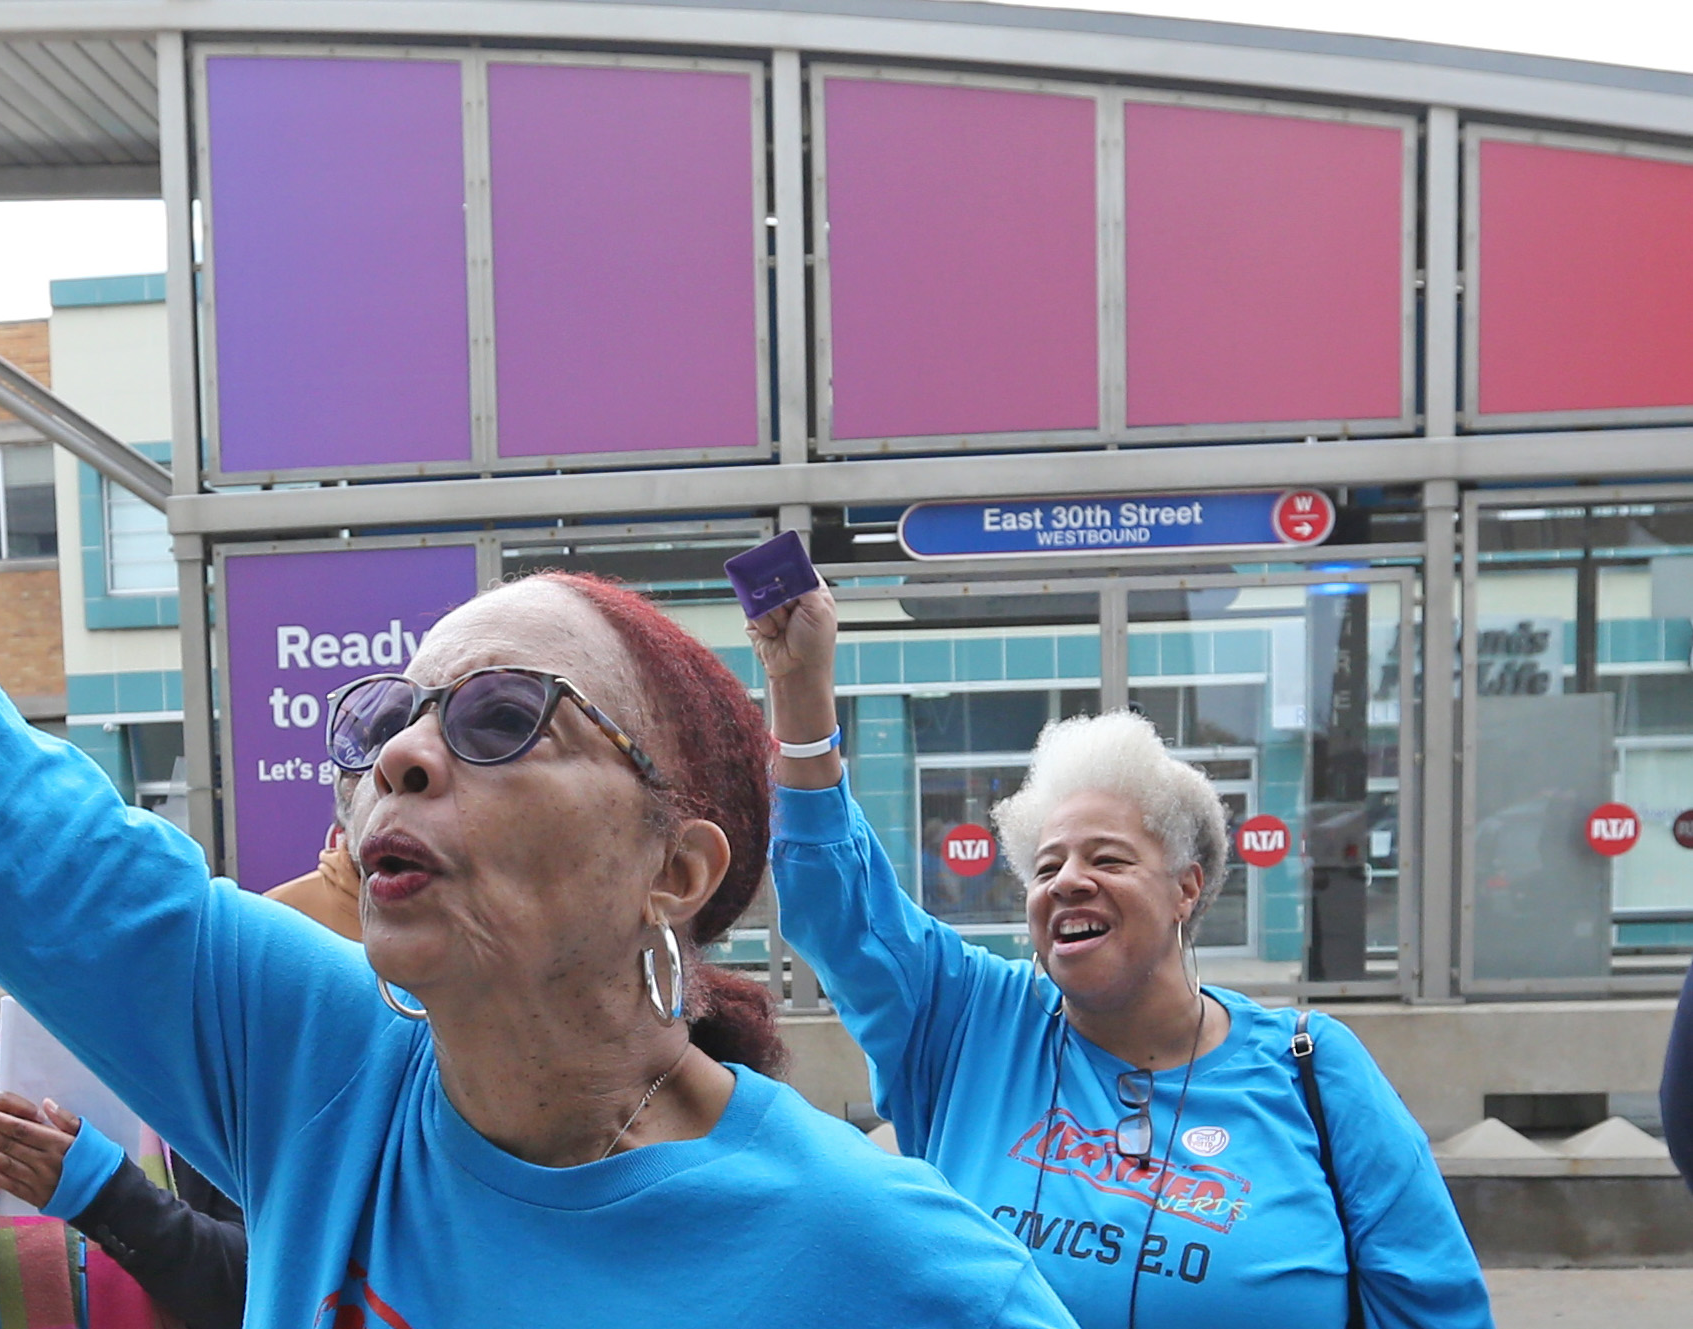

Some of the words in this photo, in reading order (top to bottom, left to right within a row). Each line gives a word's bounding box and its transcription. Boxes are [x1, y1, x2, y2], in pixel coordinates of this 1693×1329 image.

[1294, 495, 1314, 513] W
[983, 507, 1044, 532] East
[1051, 504, 1112, 529] 30th
[1119, 502, 1203, 527] Street
[1036, 527, 1150, 546] WESTBOUND
[269, 687, 320, 728] to
[258, 757, 314, 781] Let's
[1243, 829, 1285, 852] RTA
[1591, 817, 1635, 841] RTA
[948, 838, 990, 860] RTA
[1156, 1195, 1252, 1221] NERDS
[1138, 1234, 1210, 1284] 2.0
